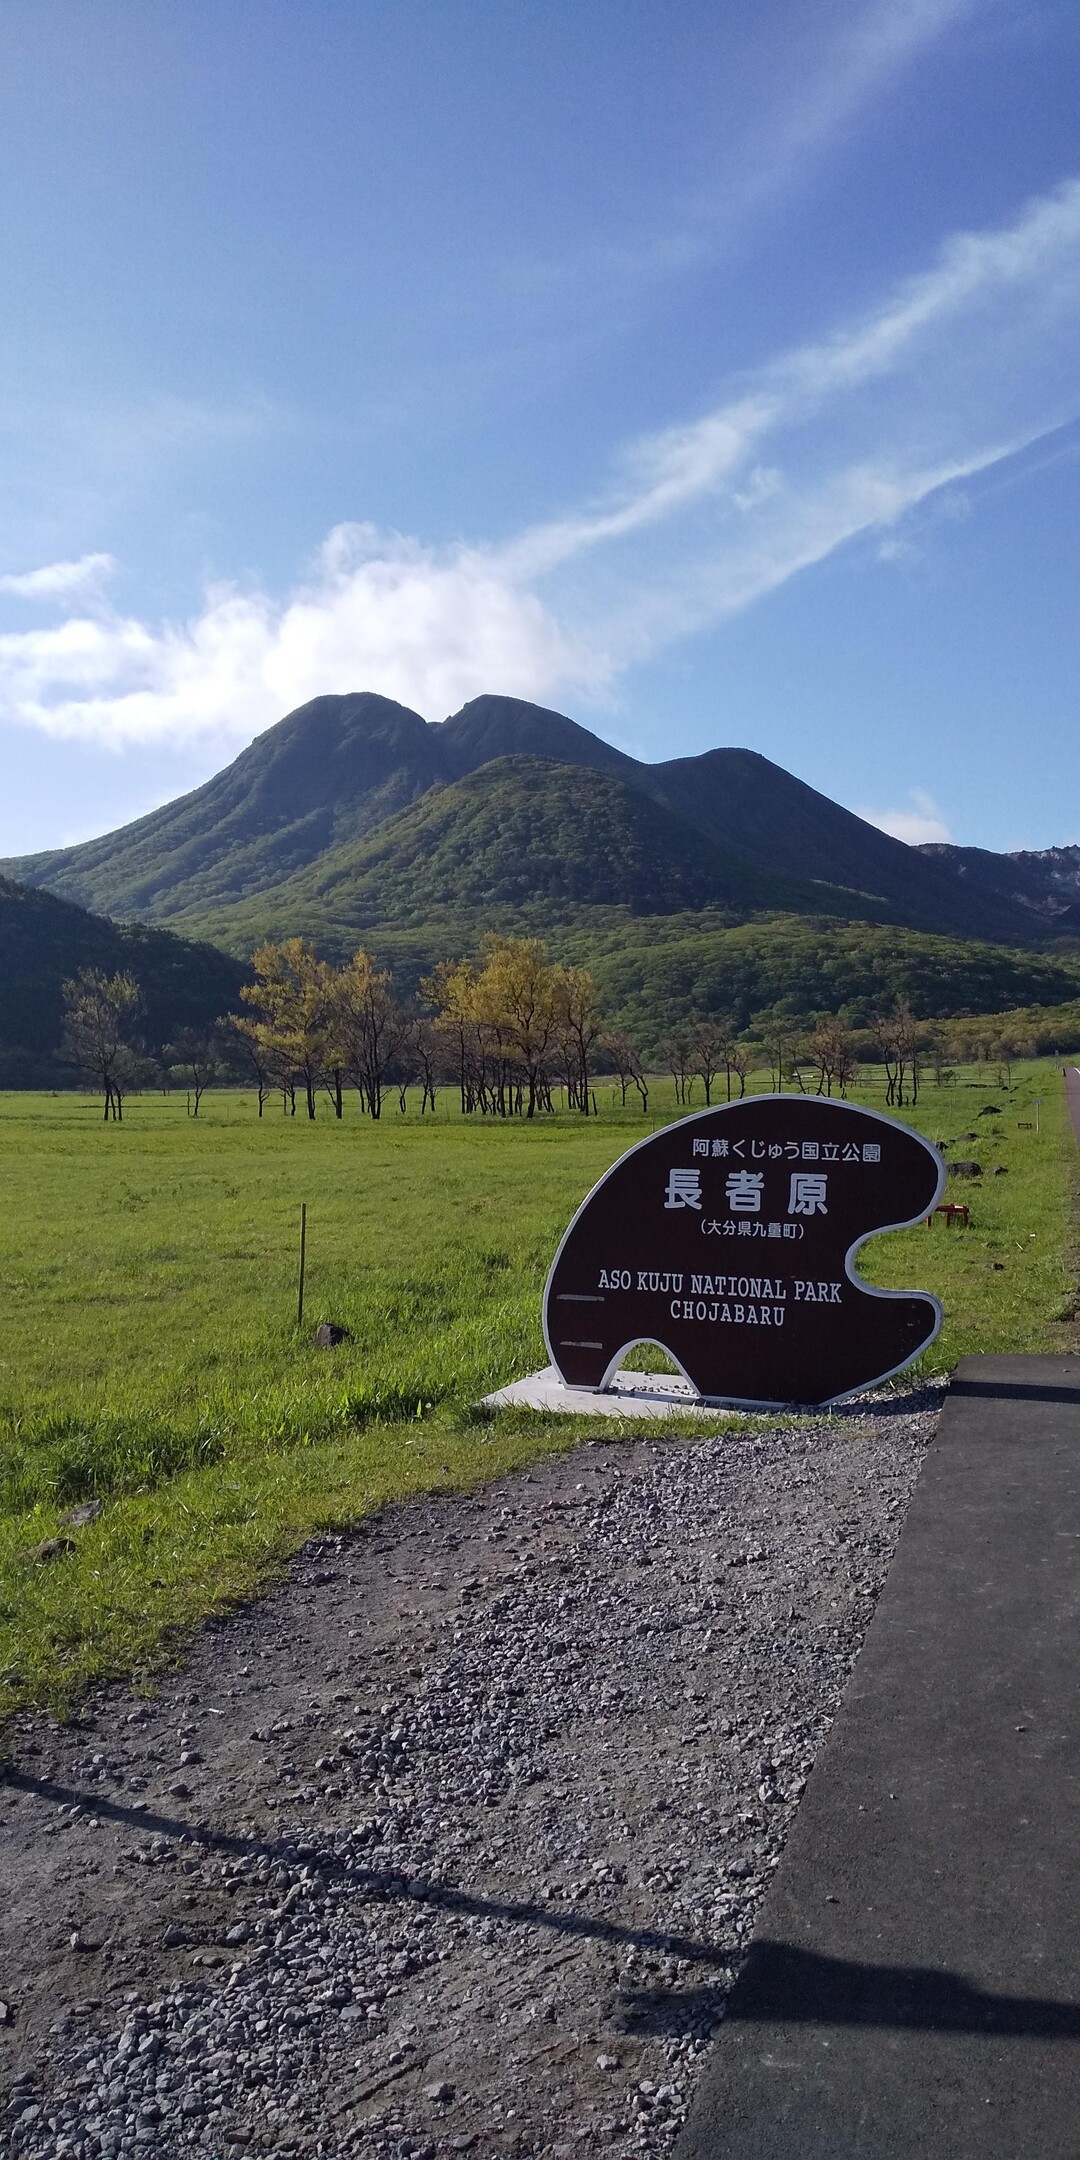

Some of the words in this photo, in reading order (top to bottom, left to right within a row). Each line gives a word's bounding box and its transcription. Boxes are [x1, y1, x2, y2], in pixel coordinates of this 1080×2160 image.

[692, 1138, 881, 1163] 阿蘇くじゅう国立公園
[664, 1169, 828, 1215] 長者原
[598, 1270, 632, 1290] ASO
[637, 1272, 684, 1293] KUJU
[691, 1275, 787, 1299] NATIONAL
[794, 1281, 843, 1304] PARK
[671, 1300, 786, 1326] CHOJABARU
